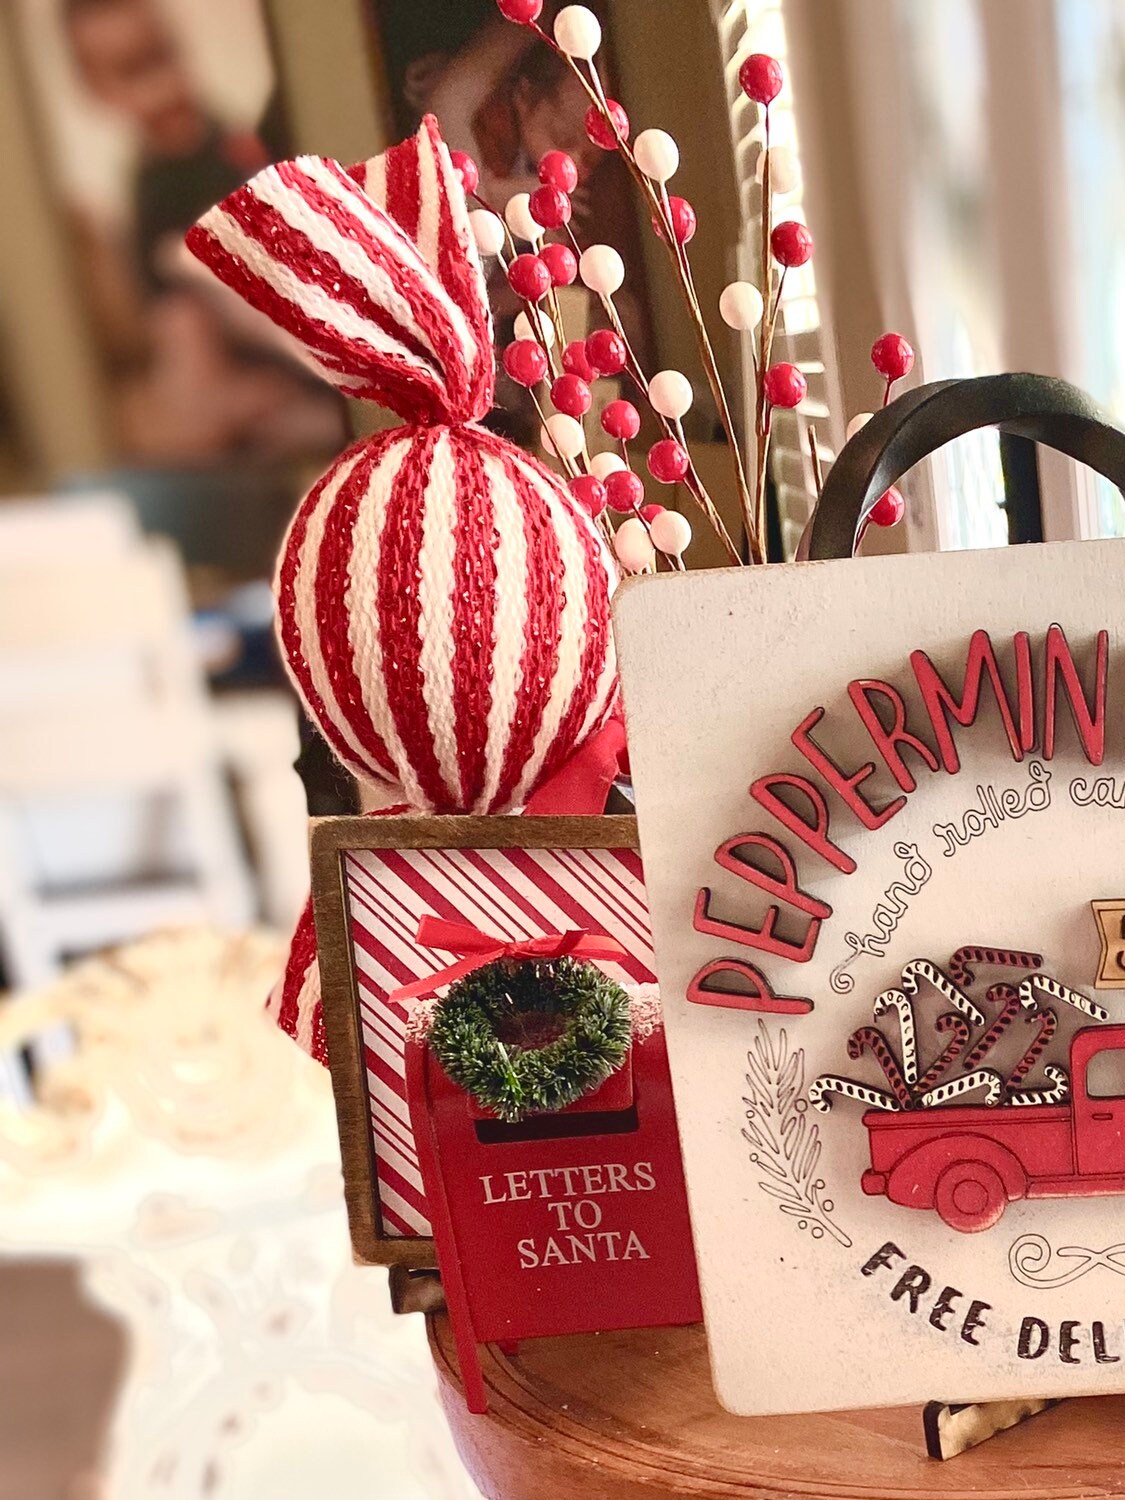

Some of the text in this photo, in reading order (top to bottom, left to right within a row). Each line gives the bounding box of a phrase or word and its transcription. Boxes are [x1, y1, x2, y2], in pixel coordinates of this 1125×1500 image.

[830, 841, 933, 994] hand
[932, 761, 1052, 857] rolled
[479, 1161, 657, 1206] LETTERS
[547, 1200, 602, 1232] TO
[517, 1230, 651, 1269] SANTA
[860, 1241, 993, 1346] FREE
